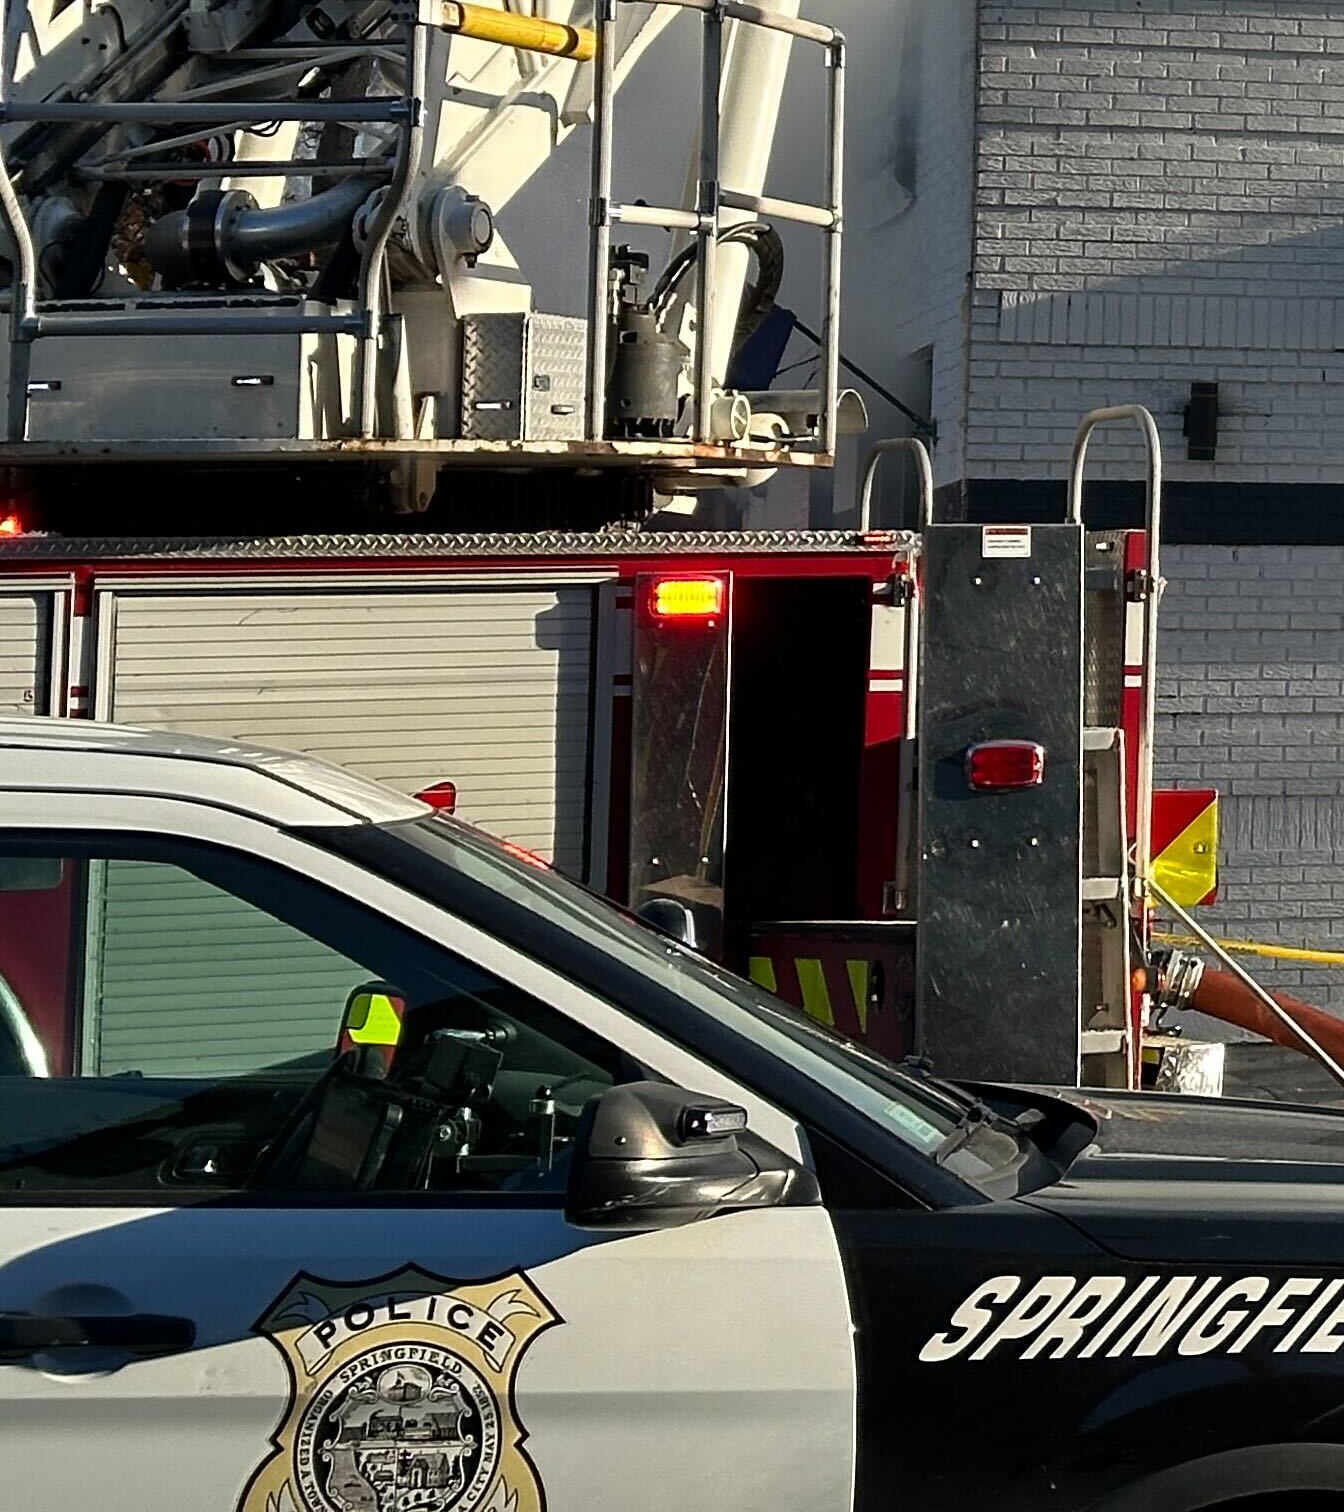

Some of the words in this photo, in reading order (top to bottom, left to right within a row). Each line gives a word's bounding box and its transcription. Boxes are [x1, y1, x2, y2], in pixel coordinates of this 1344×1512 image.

[313, 1296, 505, 1351] POLICE
[339, 1347, 462, 1383] SPRINGFIELD
[300, 1389, 333, 1465] ORGANIZED
[483, 1432, 495, 1463] MAY
